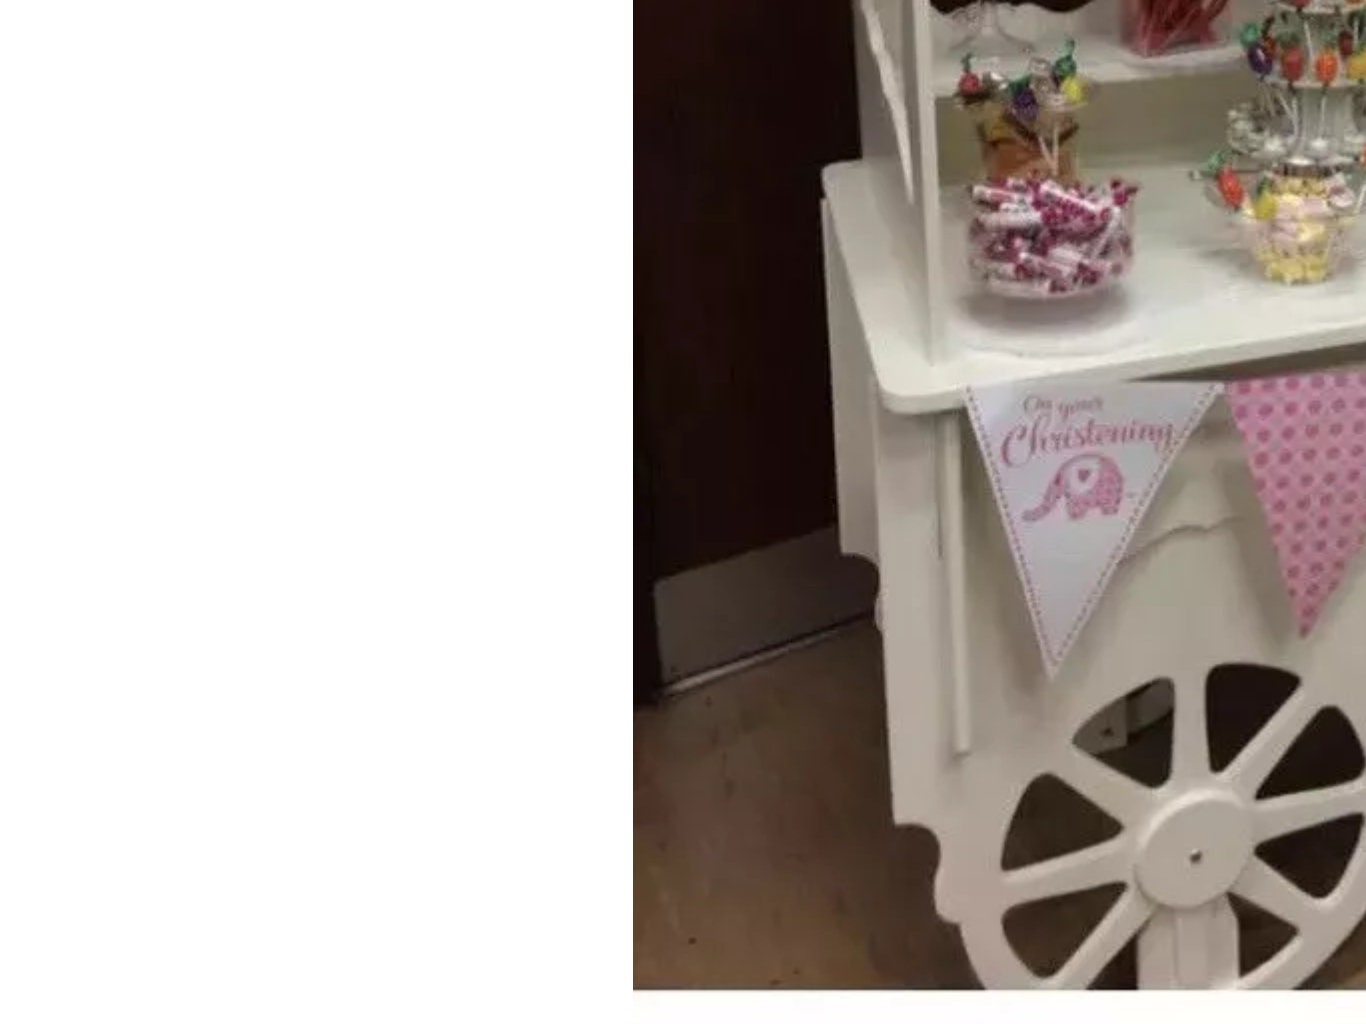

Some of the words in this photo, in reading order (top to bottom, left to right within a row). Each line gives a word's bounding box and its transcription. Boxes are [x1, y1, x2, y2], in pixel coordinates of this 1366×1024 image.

[1023, 395, 1053, 415] On
[1058, 395, 1104, 419] your
[1001, 416, 1175, 468] Christening
